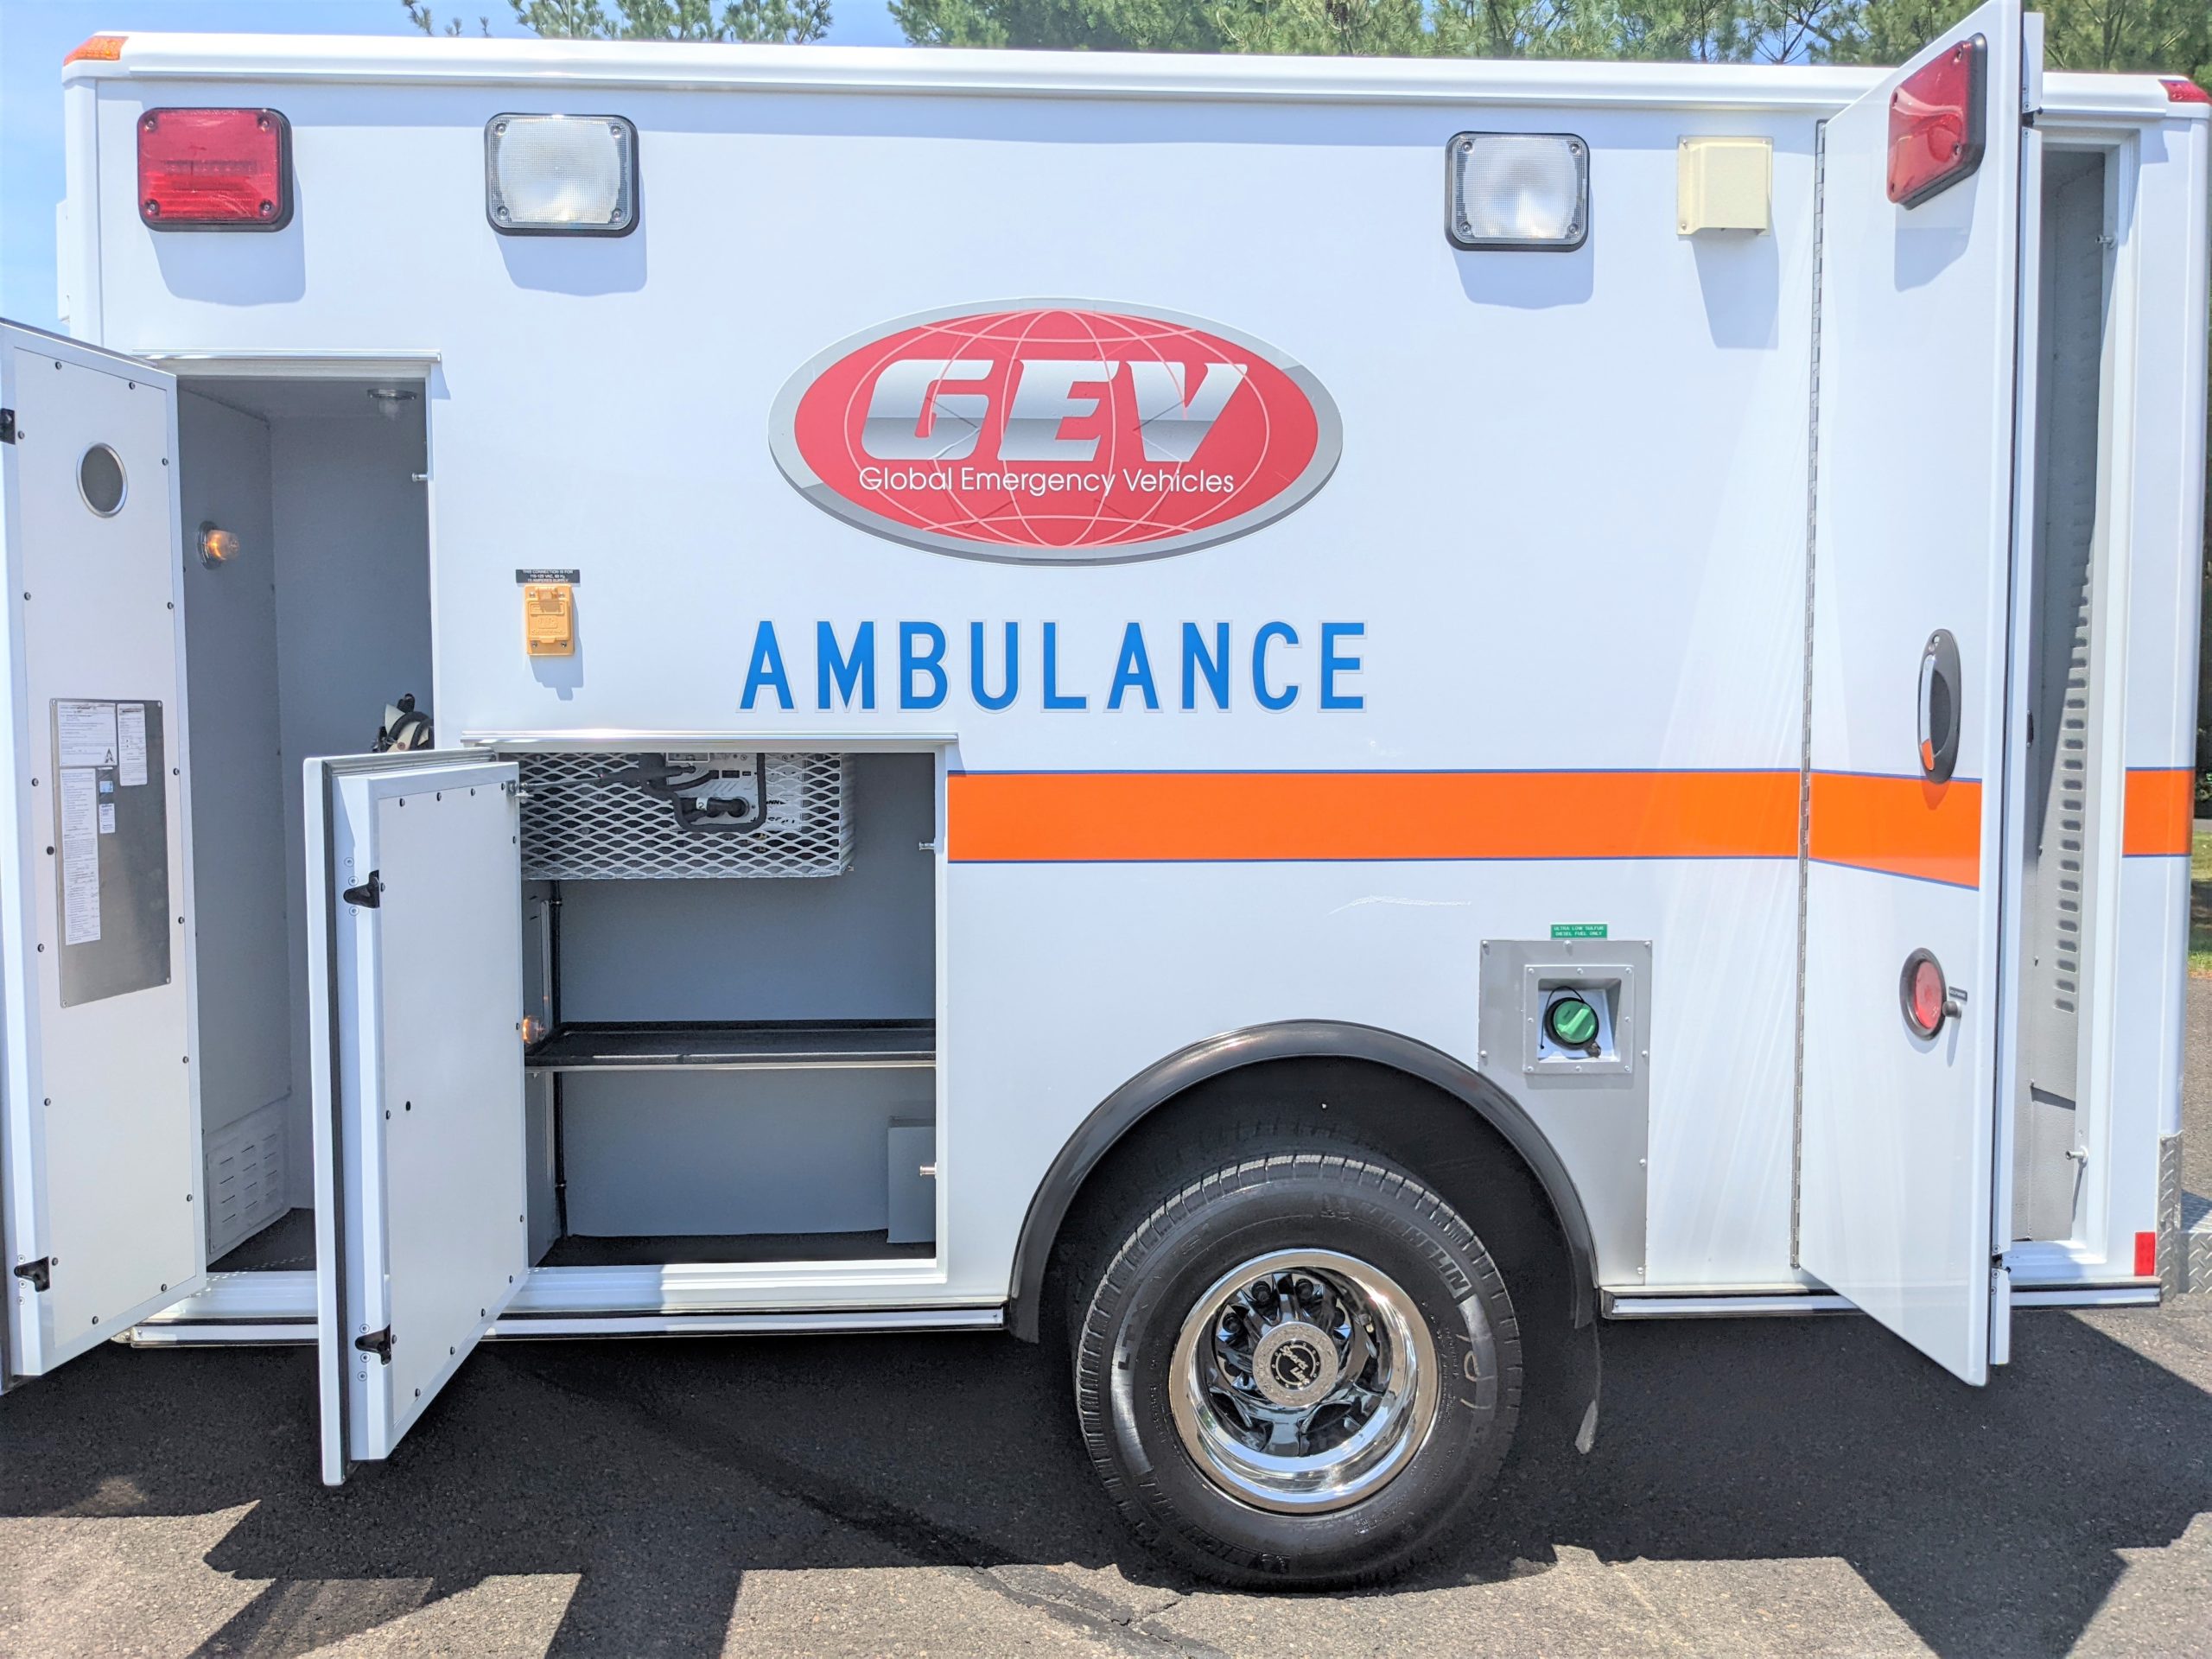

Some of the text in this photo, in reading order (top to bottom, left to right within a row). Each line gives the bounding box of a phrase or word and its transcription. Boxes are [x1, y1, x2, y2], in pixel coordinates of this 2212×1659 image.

[861, 359, 1246, 461] GEV
[859, 467, 1234, 496] Global Emergency Vehicles
[738, 620, 1366, 712] AMBULANCE
